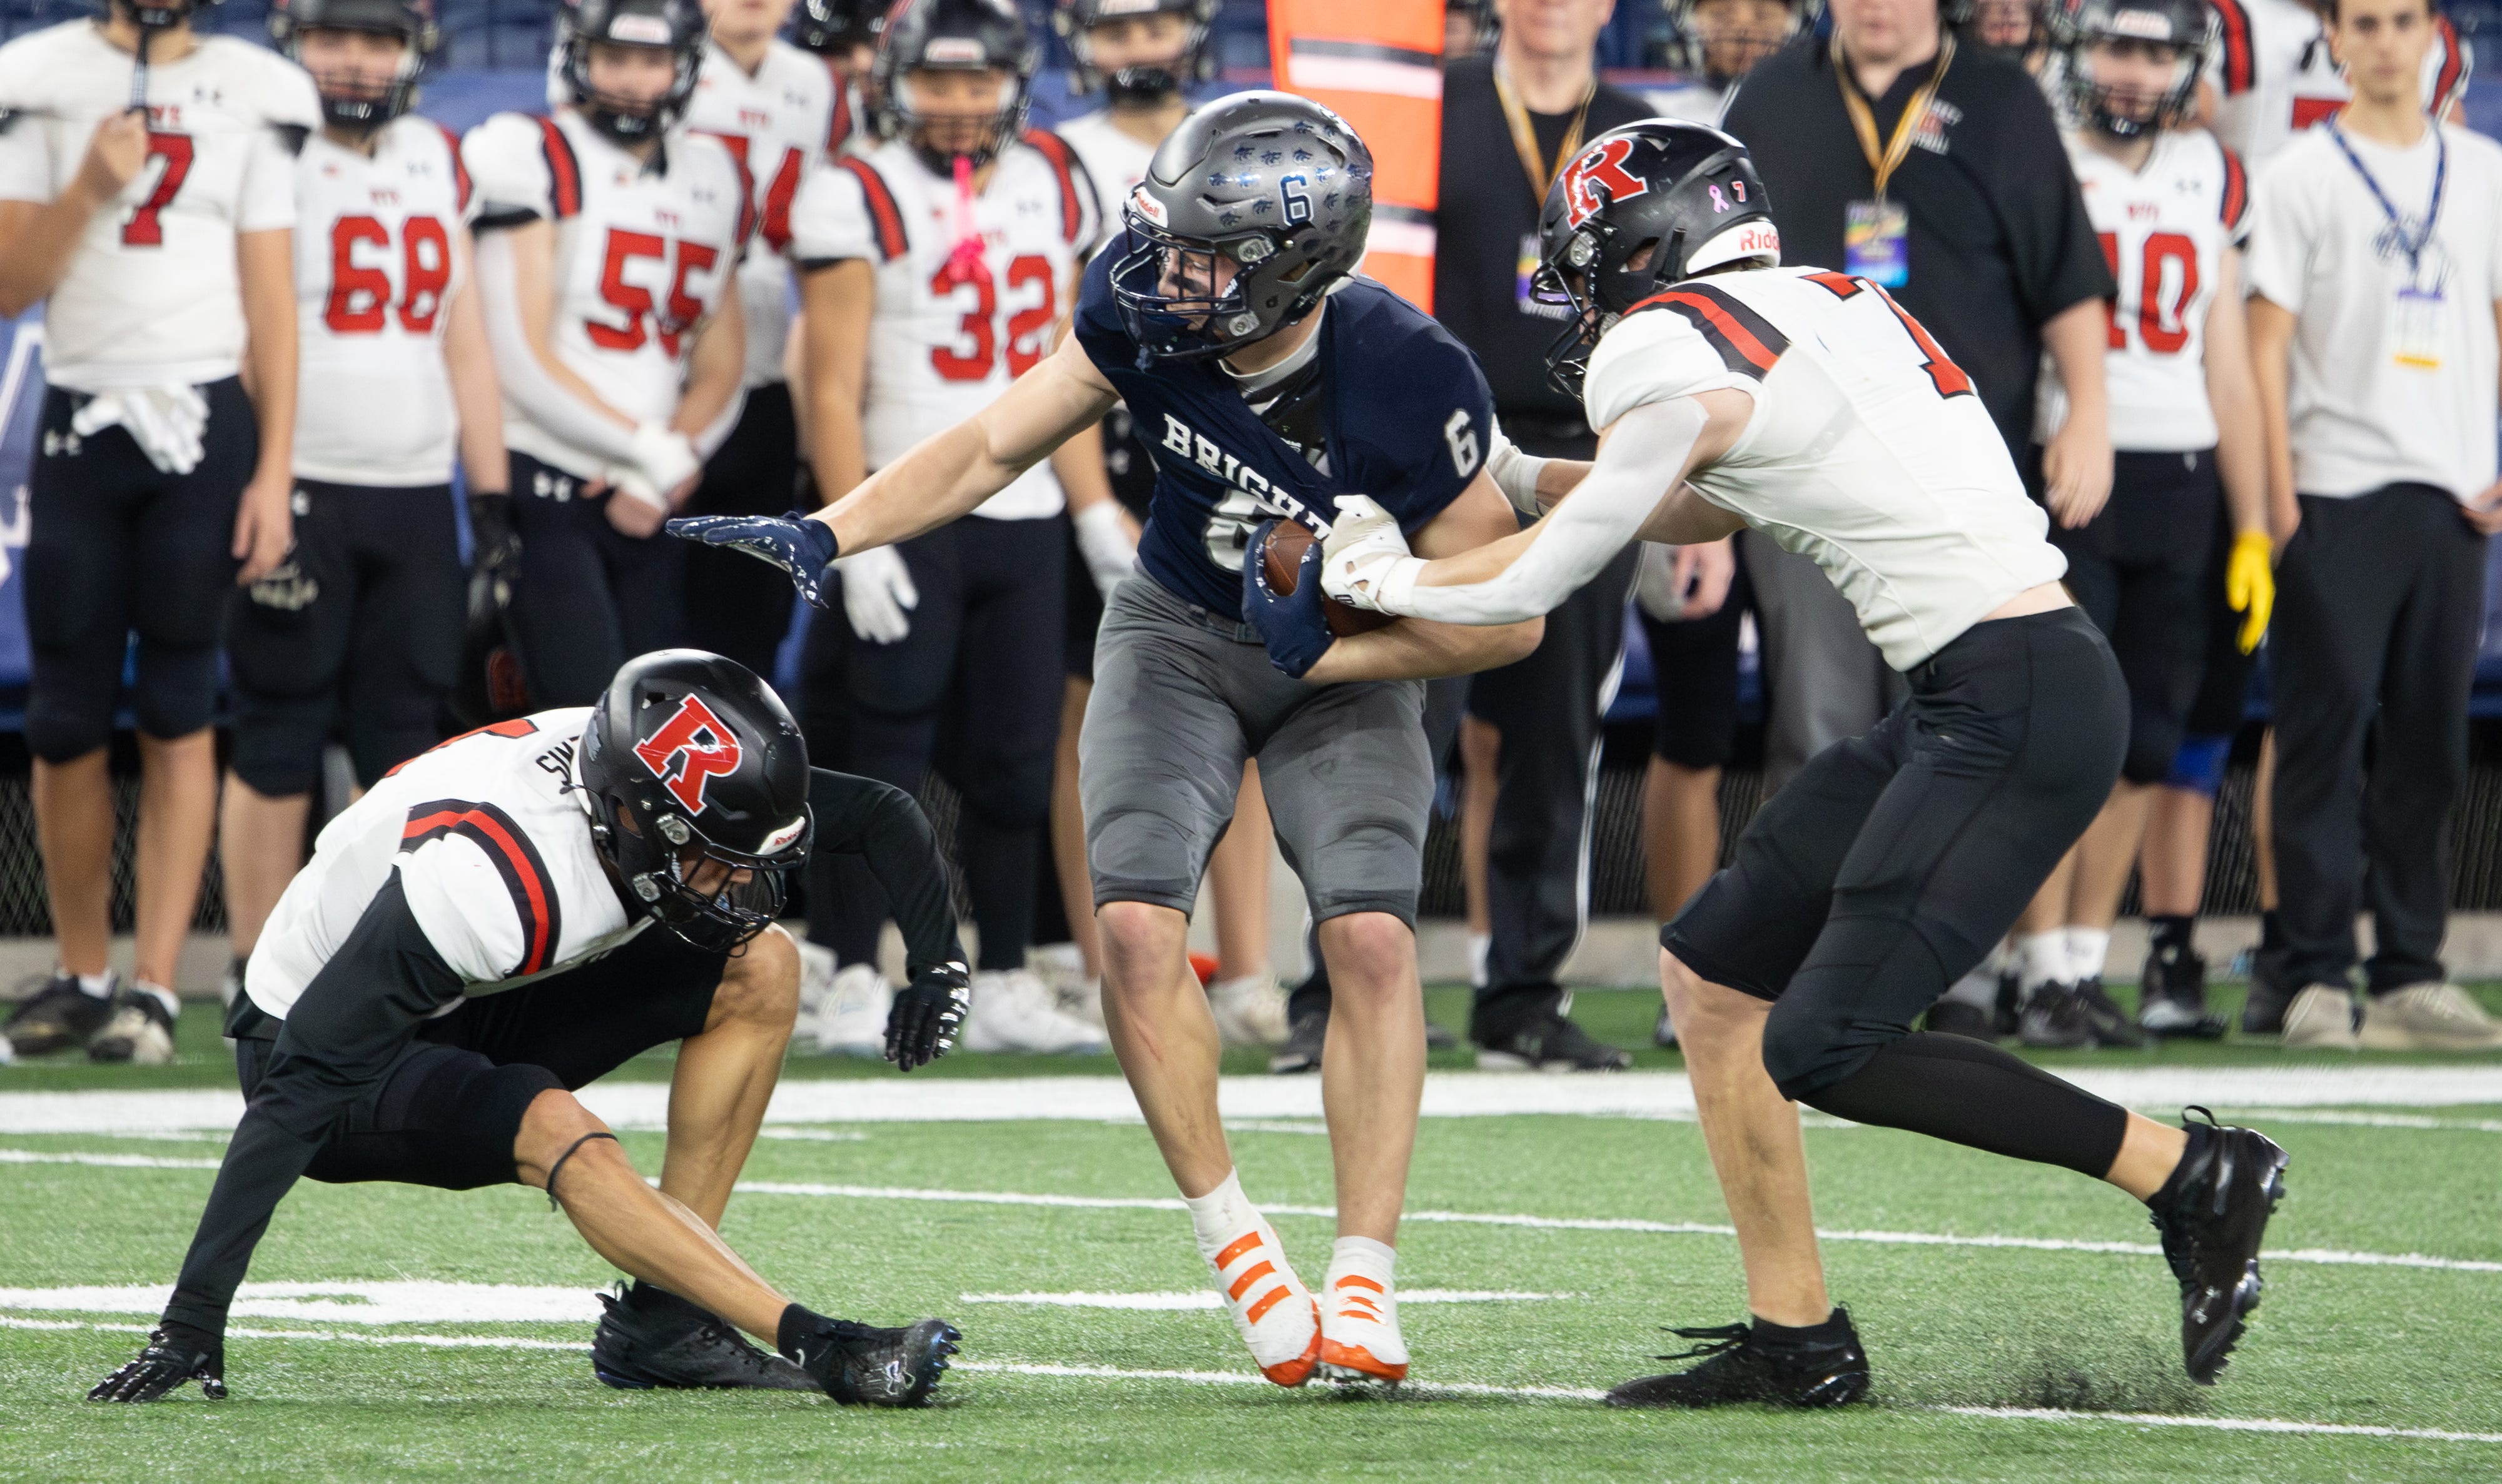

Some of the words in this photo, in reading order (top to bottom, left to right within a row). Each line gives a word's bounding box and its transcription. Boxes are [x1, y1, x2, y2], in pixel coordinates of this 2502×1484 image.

[121, 131, 195, 246] 7
[1280, 173, 1314, 227] 6
[1559, 138, 1649, 230] R
[1731, 180, 1746, 203] 7
[324, 215, 451, 335] 68
[584, 228, 719, 361] 55
[929, 255, 1055, 383] 32
[1444, 408, 1479, 478] 6
[633, 692, 743, 816] R
